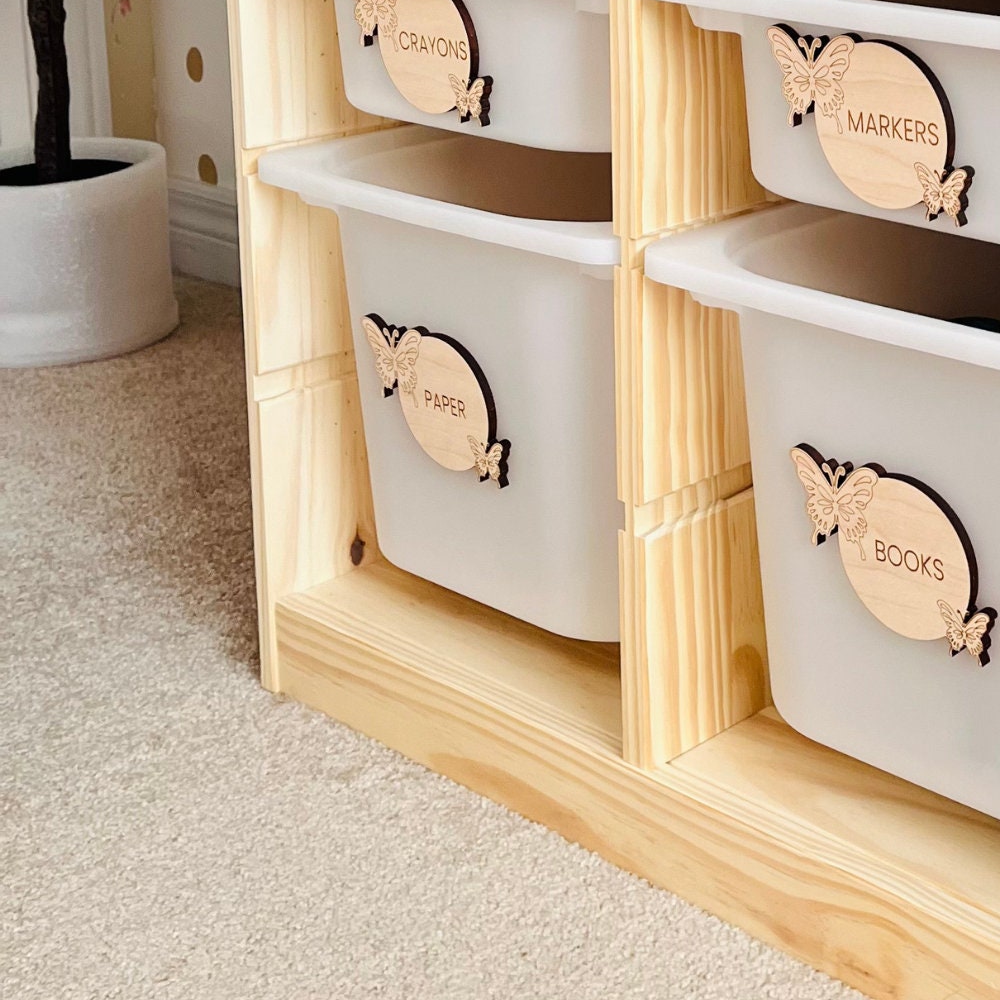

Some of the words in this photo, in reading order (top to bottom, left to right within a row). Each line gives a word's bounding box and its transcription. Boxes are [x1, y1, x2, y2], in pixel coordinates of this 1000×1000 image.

[399, 30, 468, 62] CRAYONS
[848, 109, 940, 148] MARKERS
[424, 390, 467, 421] PAPER
[874, 538, 945, 583] BOOKS
